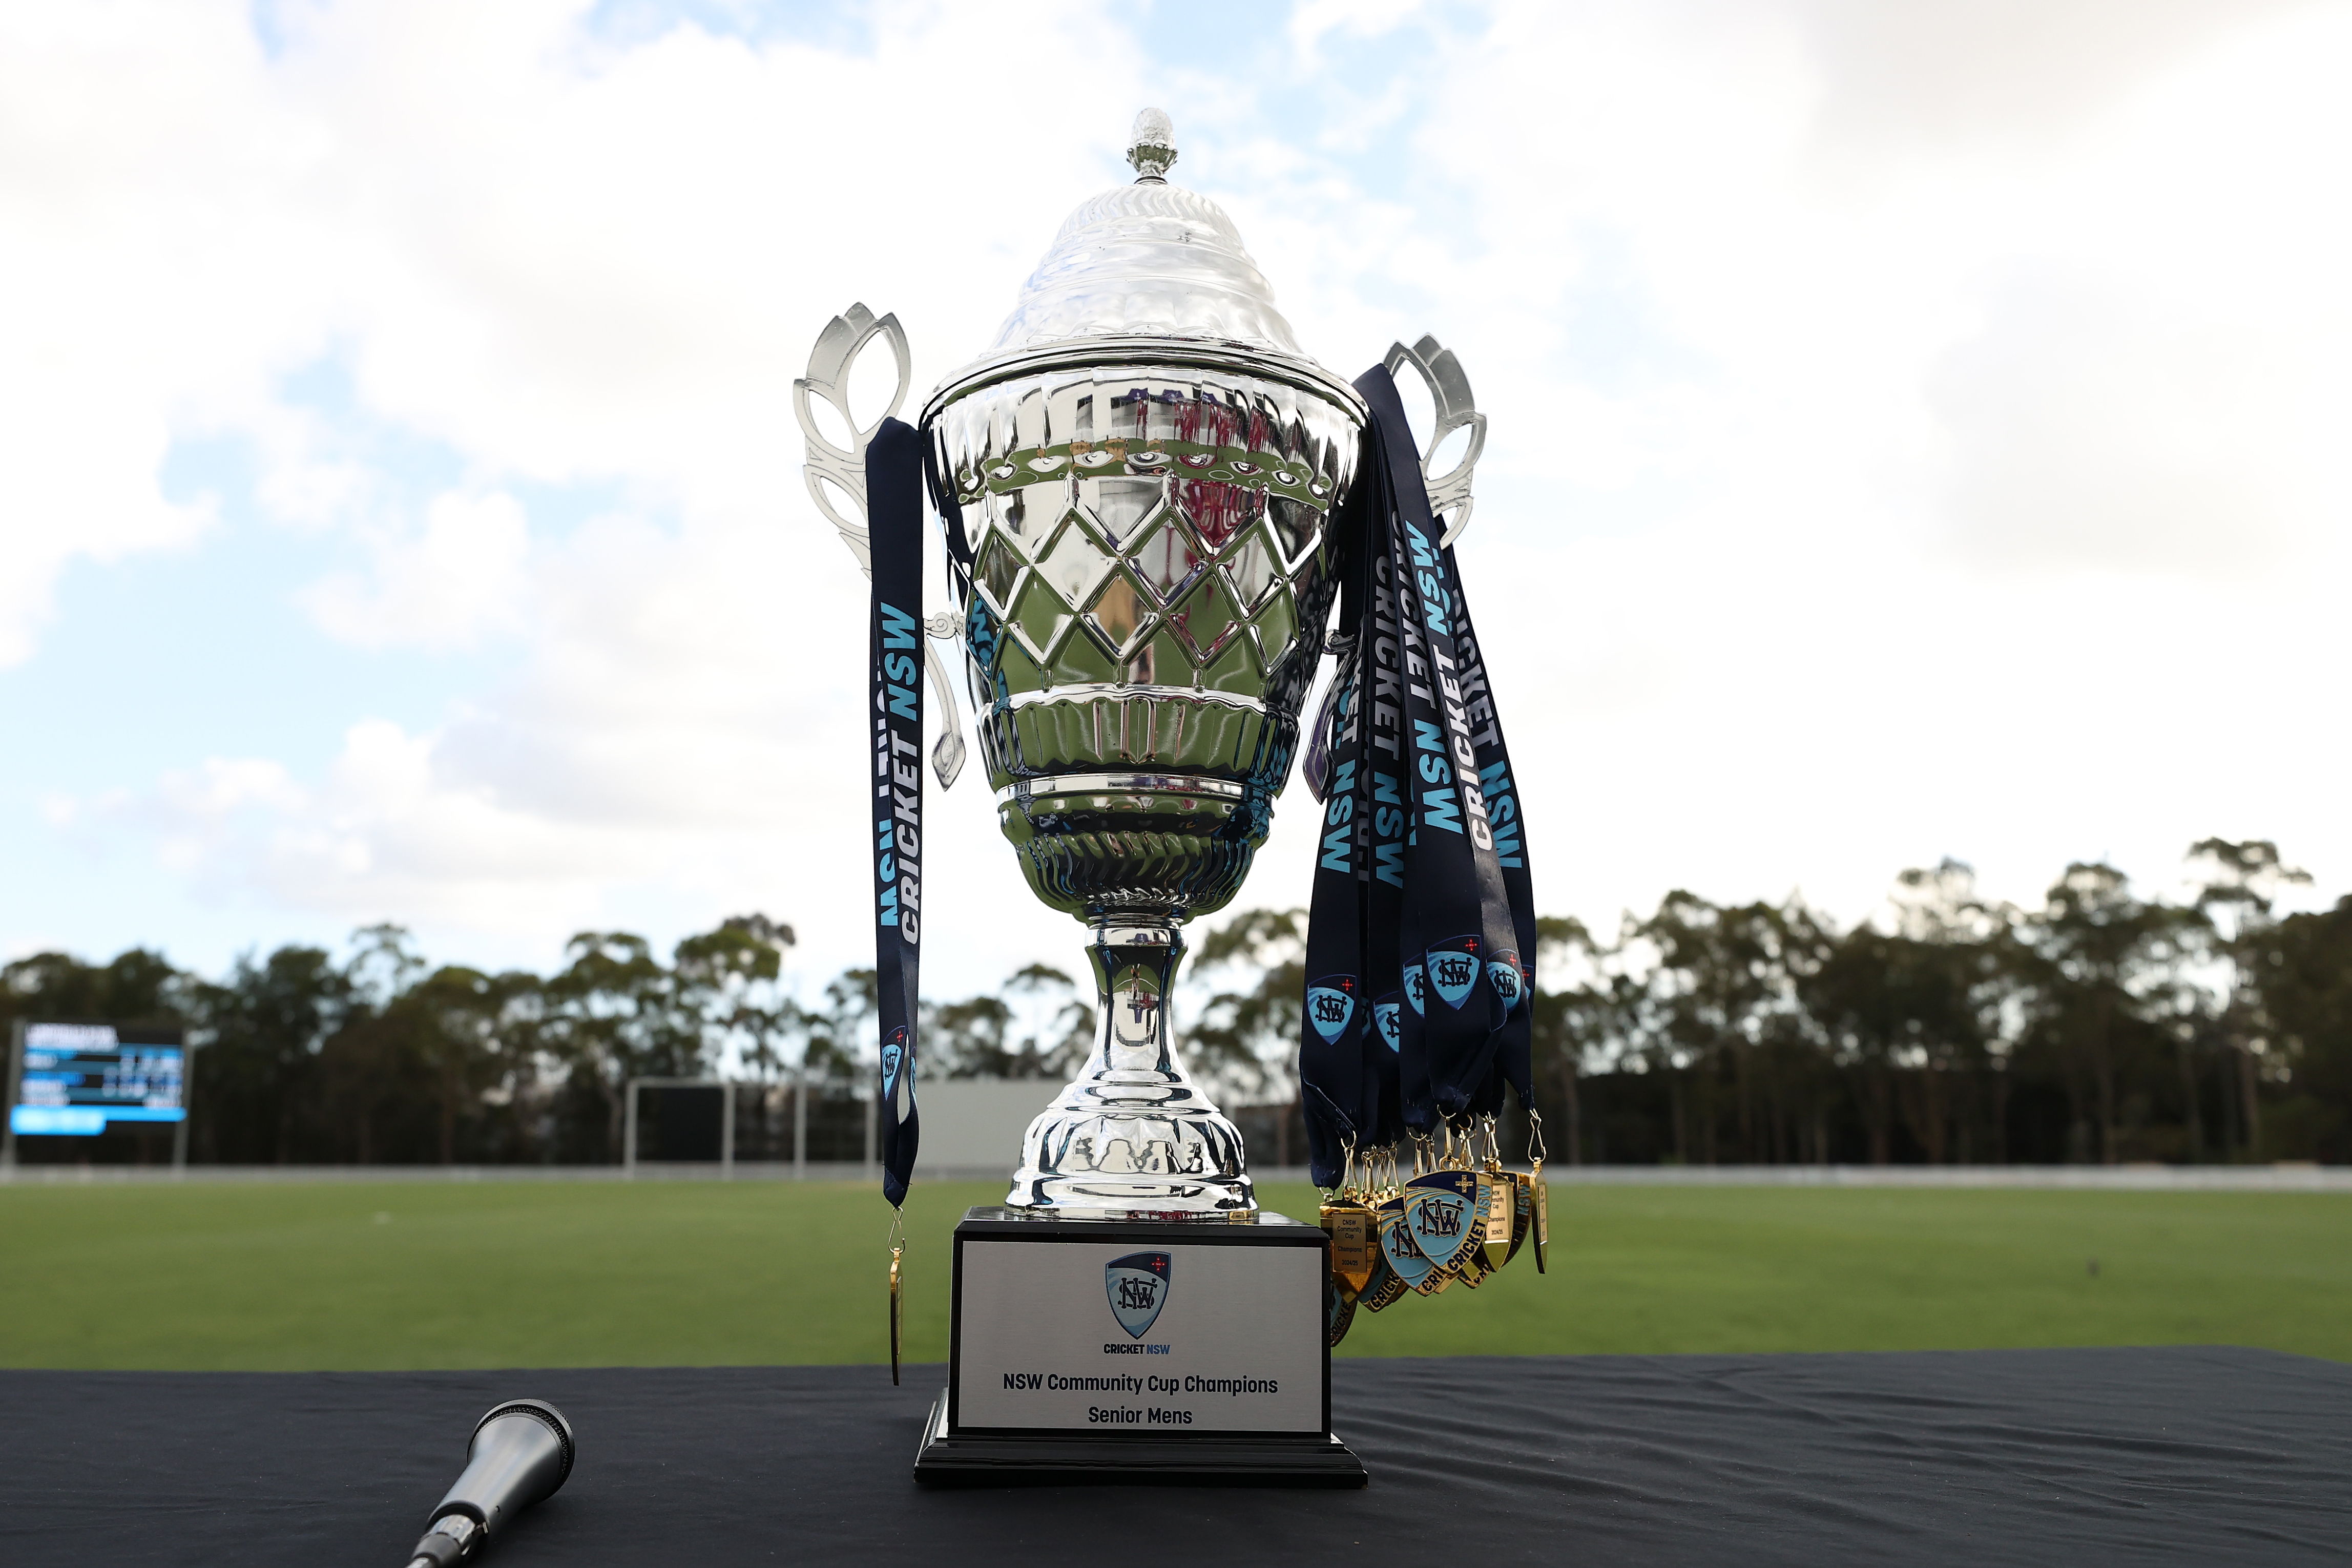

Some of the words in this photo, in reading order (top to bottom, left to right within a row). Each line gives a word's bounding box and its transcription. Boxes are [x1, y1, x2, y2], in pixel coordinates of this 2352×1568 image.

[1405, 519, 1448, 637] NSW
[880, 601, 917, 722] NSW
[1375, 555, 1402, 761] CRICKET
[1414, 718, 1464, 835] NSW
[1433, 644, 1492, 851] CRICKET
[1453, 588, 1500, 749] ICKET
[1480, 760, 1523, 868] NSW
[891, 728, 919, 945] CRICKET
[1321, 759, 1356, 874] NSW
[1374, 771, 1404, 889] NSW
[1447, 1219, 1486, 1271] CRICKET
[1475, 1183, 1492, 1218] NSW
[1517, 1184, 1531, 1216] NSW
[1330, 1302, 1351, 1344] RICKE
[1370, 1273, 1401, 1308] CRICK
[1003, 1373, 1044, 1390] NSW
[1048, 1373, 1144, 1395] Community
[1148, 1375, 1180, 1396] Cup
[1184, 1375, 1278, 1397] Champions
[1104, 1344, 1145, 1354] CRICKET
[1147, 1344, 1171, 1355] NSW
[1088, 1405, 1143, 1423] Senior
[1148, 1407, 1193, 1424] Mens
